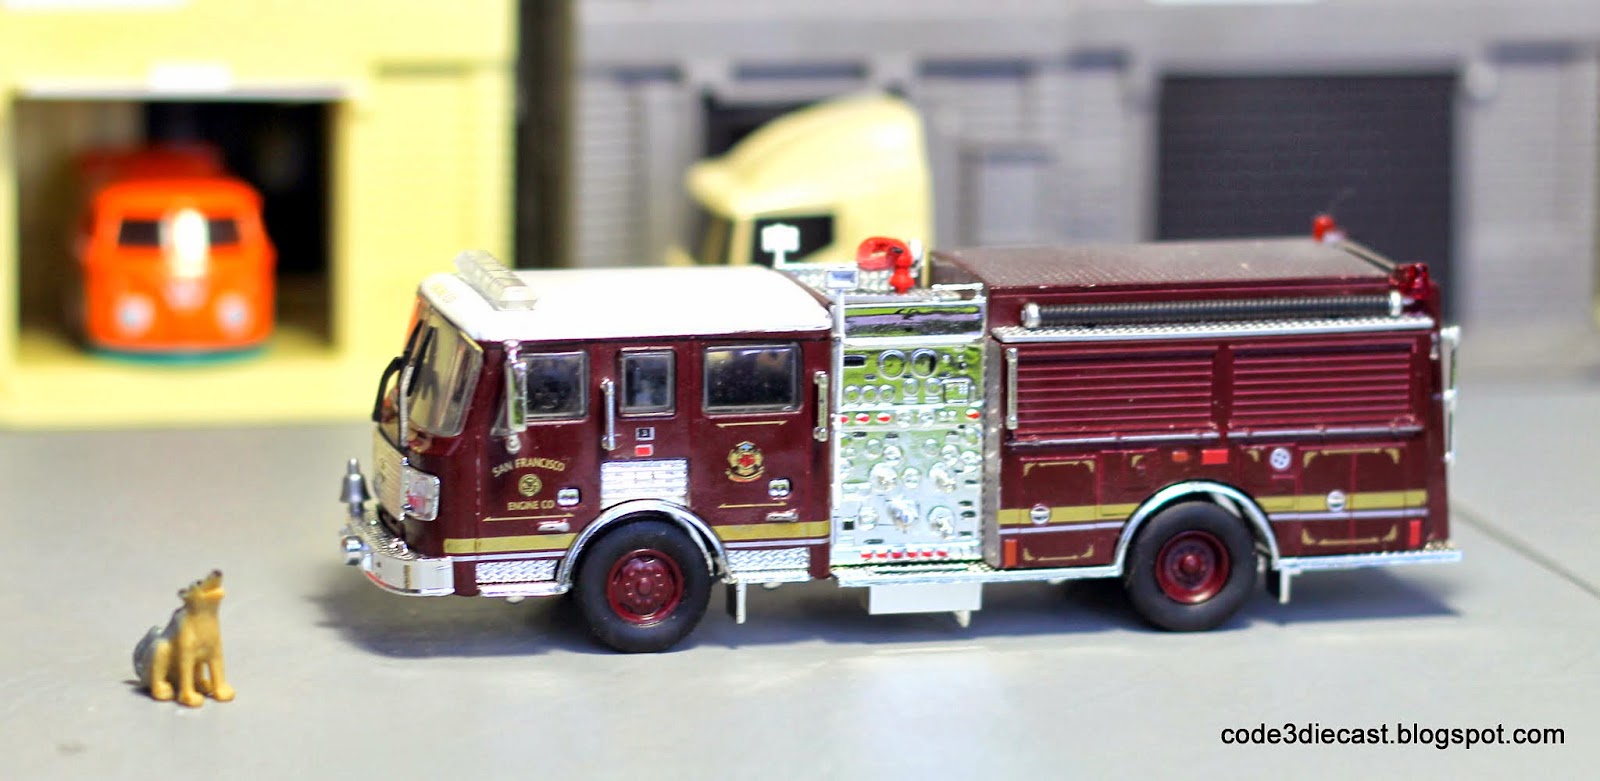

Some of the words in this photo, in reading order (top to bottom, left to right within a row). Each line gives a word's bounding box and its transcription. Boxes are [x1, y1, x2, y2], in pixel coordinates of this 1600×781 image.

[492, 461, 513, 477] SAN
[515, 457, 565, 471] FRANCISCO
[507, 501, 539, 511] ENGINE
[541, 500, 555, 509] CO
